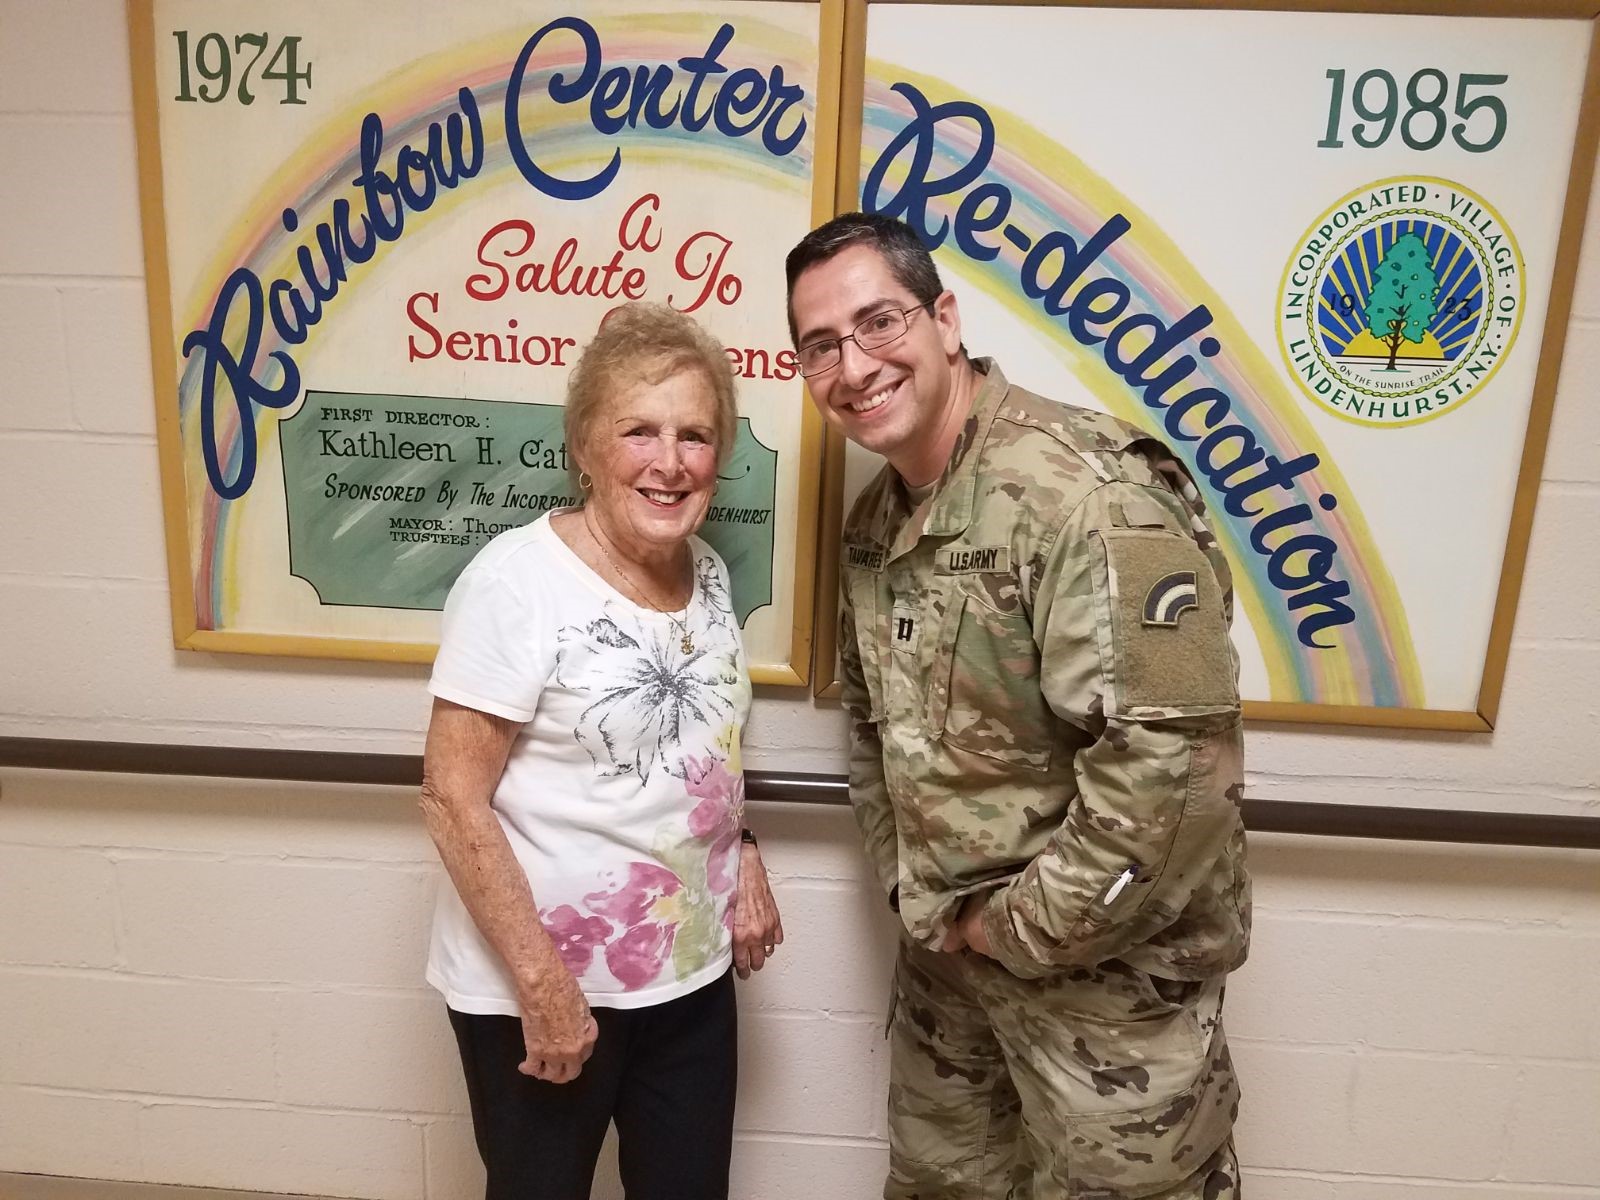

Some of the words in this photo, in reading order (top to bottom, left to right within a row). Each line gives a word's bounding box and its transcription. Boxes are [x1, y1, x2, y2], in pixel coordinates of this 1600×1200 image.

[173, 31, 312, 105] 1974
[1317, 68, 1508, 153] 1985
[183, 87, 484, 499] Rainbow
[505, 16, 807, 200] Center
[465, 219, 647, 300] Salute
[667, 231, 743, 313] To
[1286, 185, 1427, 320] INCORPORATED
[1448, 192, 1516, 278] VILLAGE
[1496, 295, 1516, 328] OF
[406, 292, 577, 366] Senior
[1331, 293, 1355, 317] 19
[862, 82, 1356, 649] Re-dedication
[1354, 374, 1372, 387] THE
[1374, 380, 1415, 390] SUNRISE
[1420, 367, 1445, 384] TRAIL
[318, 429, 457, 463] Kathleen
[475, 436, 502, 465] H.
[320, 407, 373, 423] FIRST
[324, 472, 426, 503] SPONSORED
[436, 480, 459, 511] By
[470, 482, 495, 507] The
[849, 546, 883, 569] TAVARES
